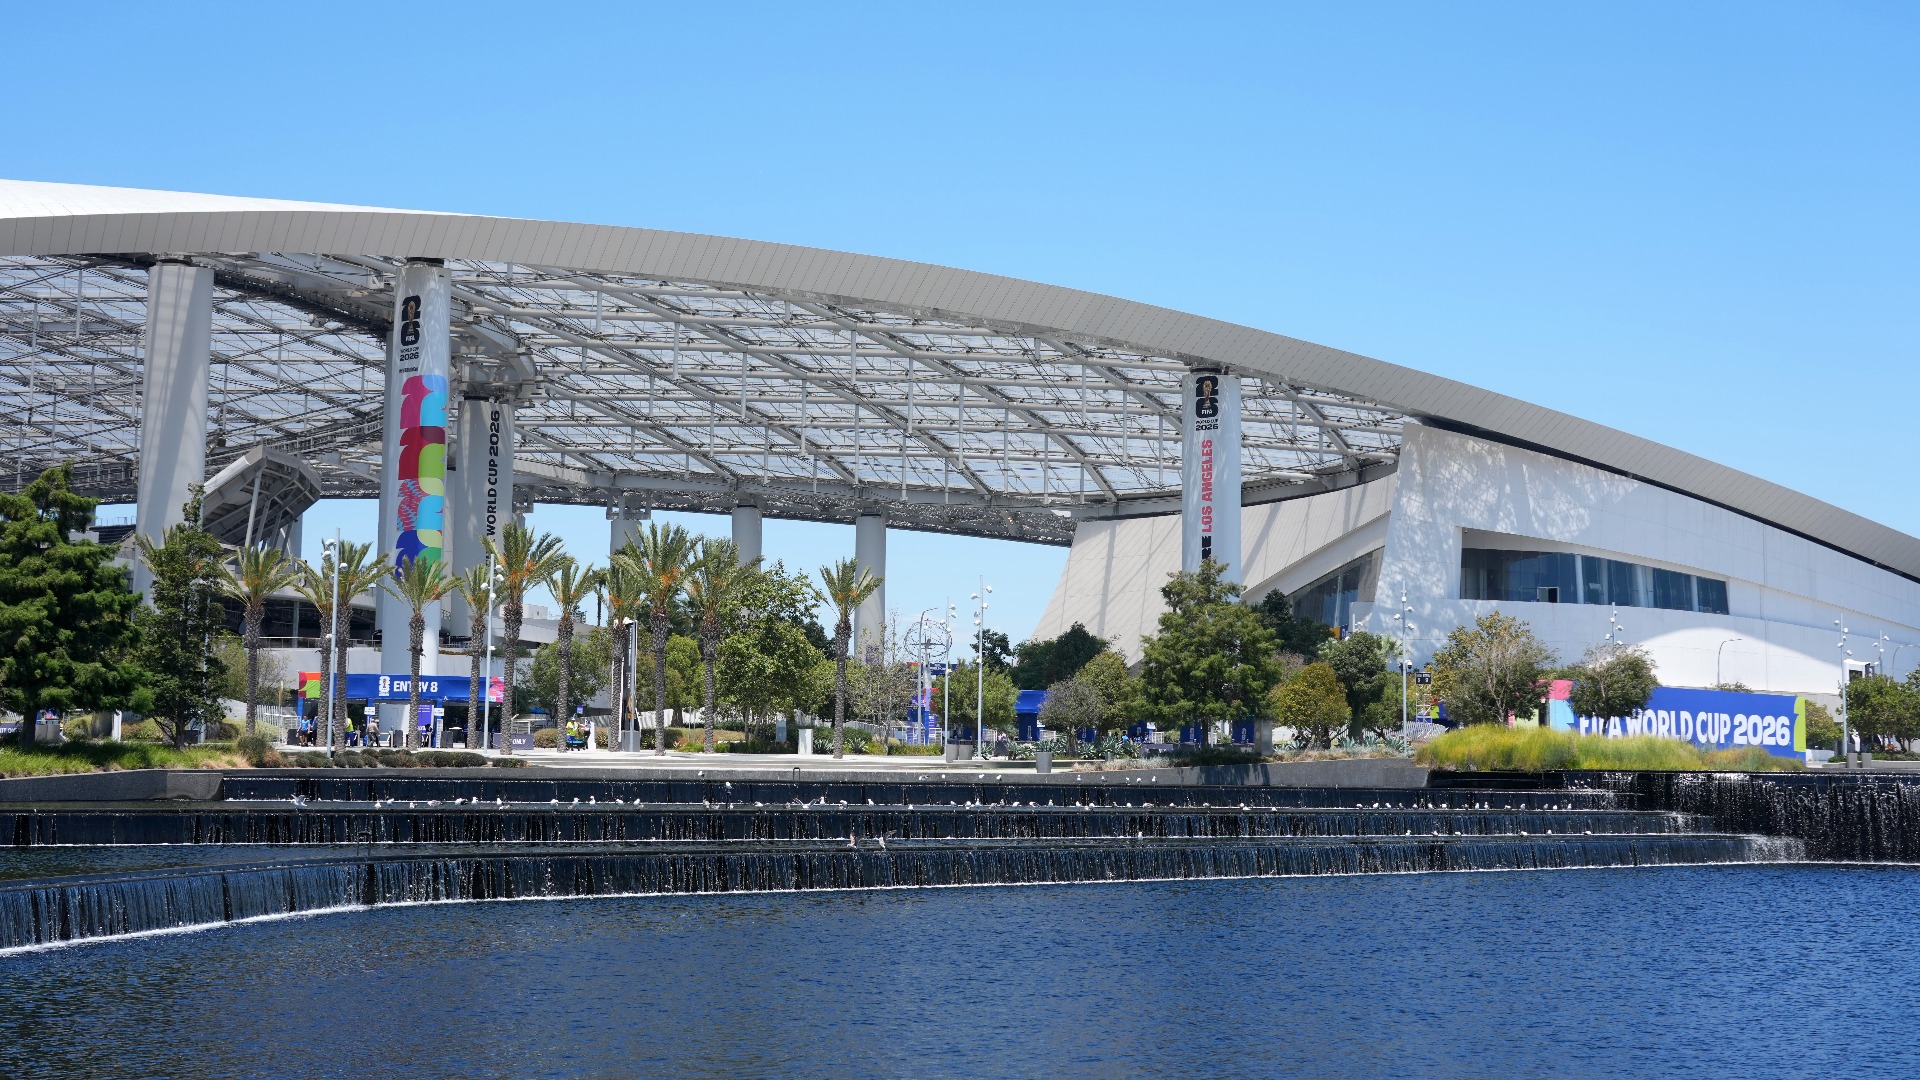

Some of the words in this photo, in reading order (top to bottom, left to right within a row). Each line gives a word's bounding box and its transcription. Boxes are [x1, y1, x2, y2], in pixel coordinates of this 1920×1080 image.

[399, 352, 420, 362] 2026
[489, 410, 500, 457] 2026
[1195, 423, 1219, 431] 2026
[488, 458, 498, 486] CUP
[1201, 439, 1213, 503] ANGELES
[486, 488, 498, 536] WORLD
[1201, 505, 1213, 533] LOS
[430, 681, 438, 693] 8
[1625, 709, 1694, 742] WORLD
[1695, 711, 1731, 744] CUP
[1733, 713, 1791, 746] 2026
